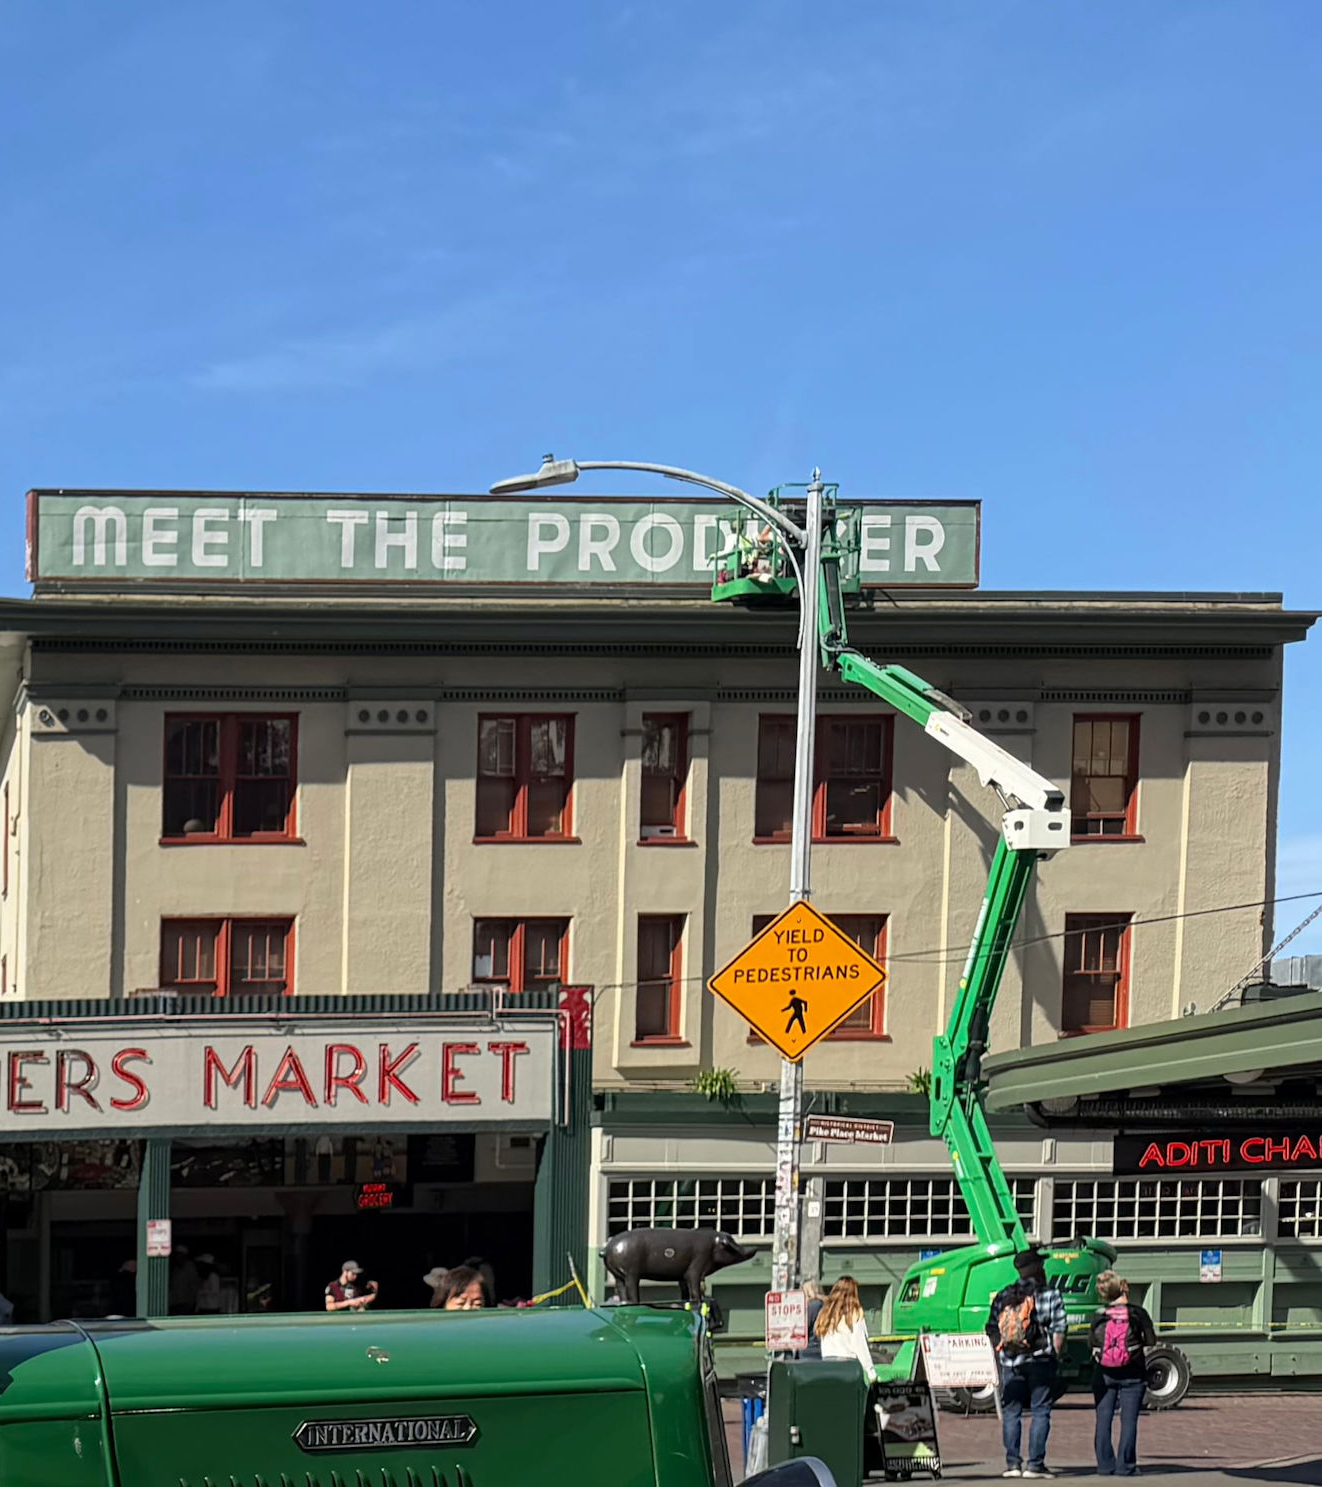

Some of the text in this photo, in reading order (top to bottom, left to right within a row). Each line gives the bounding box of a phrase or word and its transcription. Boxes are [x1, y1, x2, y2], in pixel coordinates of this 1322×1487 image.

[72, 505, 945, 572] MEET THE PRODER
[773, 928, 825, 945] YIELD
[787, 948, 808, 963] TO
[733, 964, 861, 984] PEDESTRIANS
[202, 1041, 530, 1109] MARKET
[809, 1126, 888, 1141] Pike Place Market
[1138, 1134, 1322, 1169] ADITI CHA
[771, 1303, 802, 1316] STOPS
[306, 1418, 465, 1446] INTERNATIONAL
